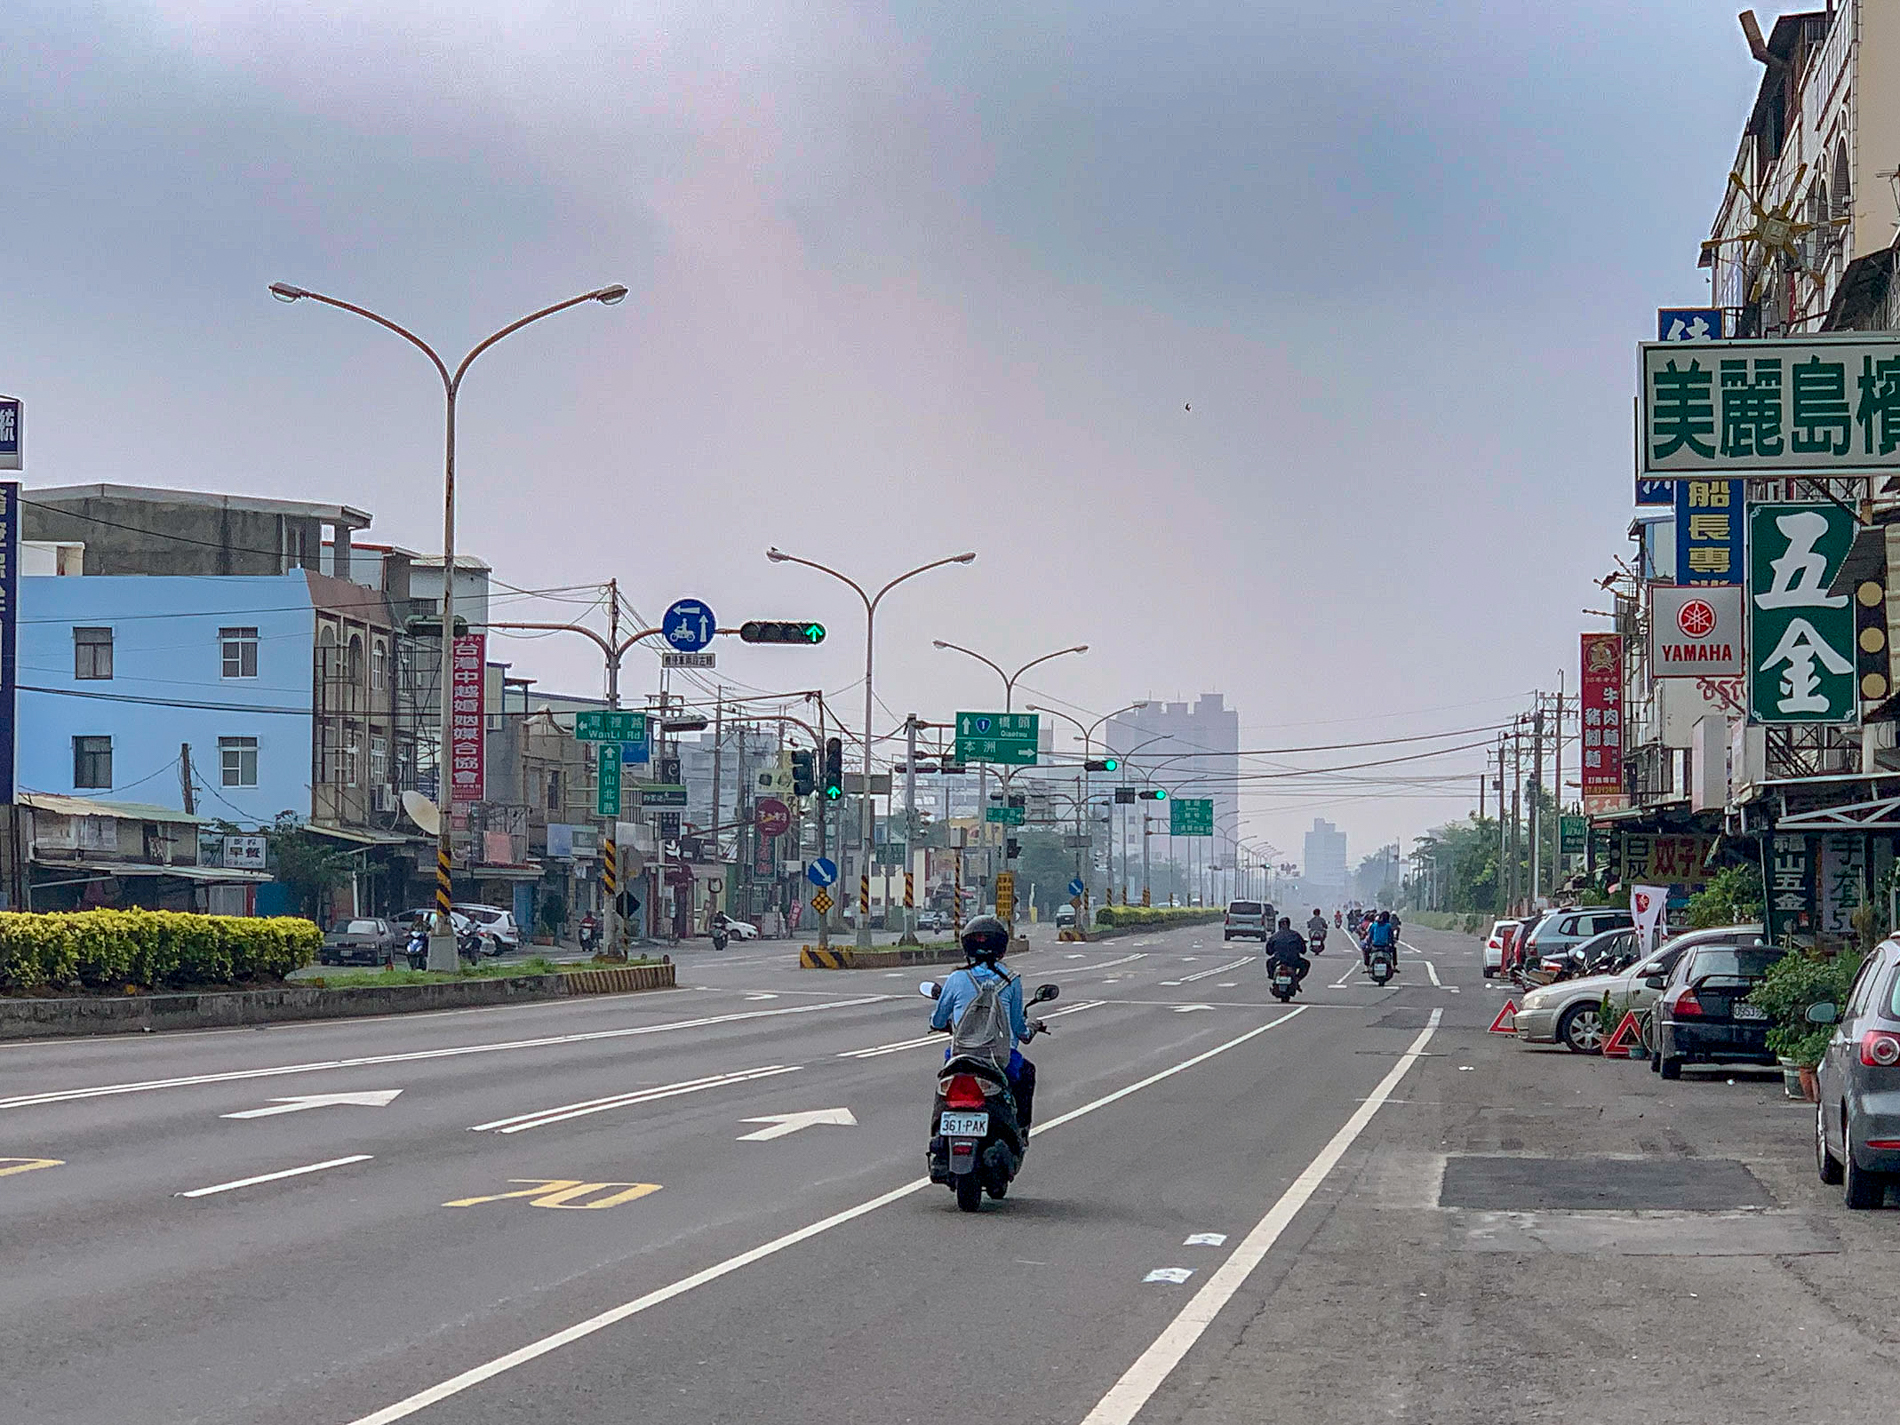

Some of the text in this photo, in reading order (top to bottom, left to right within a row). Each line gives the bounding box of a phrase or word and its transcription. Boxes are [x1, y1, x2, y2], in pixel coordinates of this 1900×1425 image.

[1688, 480, 1731, 586] 船長專
[1753, 510, 1854, 714] 五金
[1661, 643, 1733, 662] YAMAHA
[942, 1119, 987, 1133] 361-PAK
[441, 1179, 664, 1209] 70
